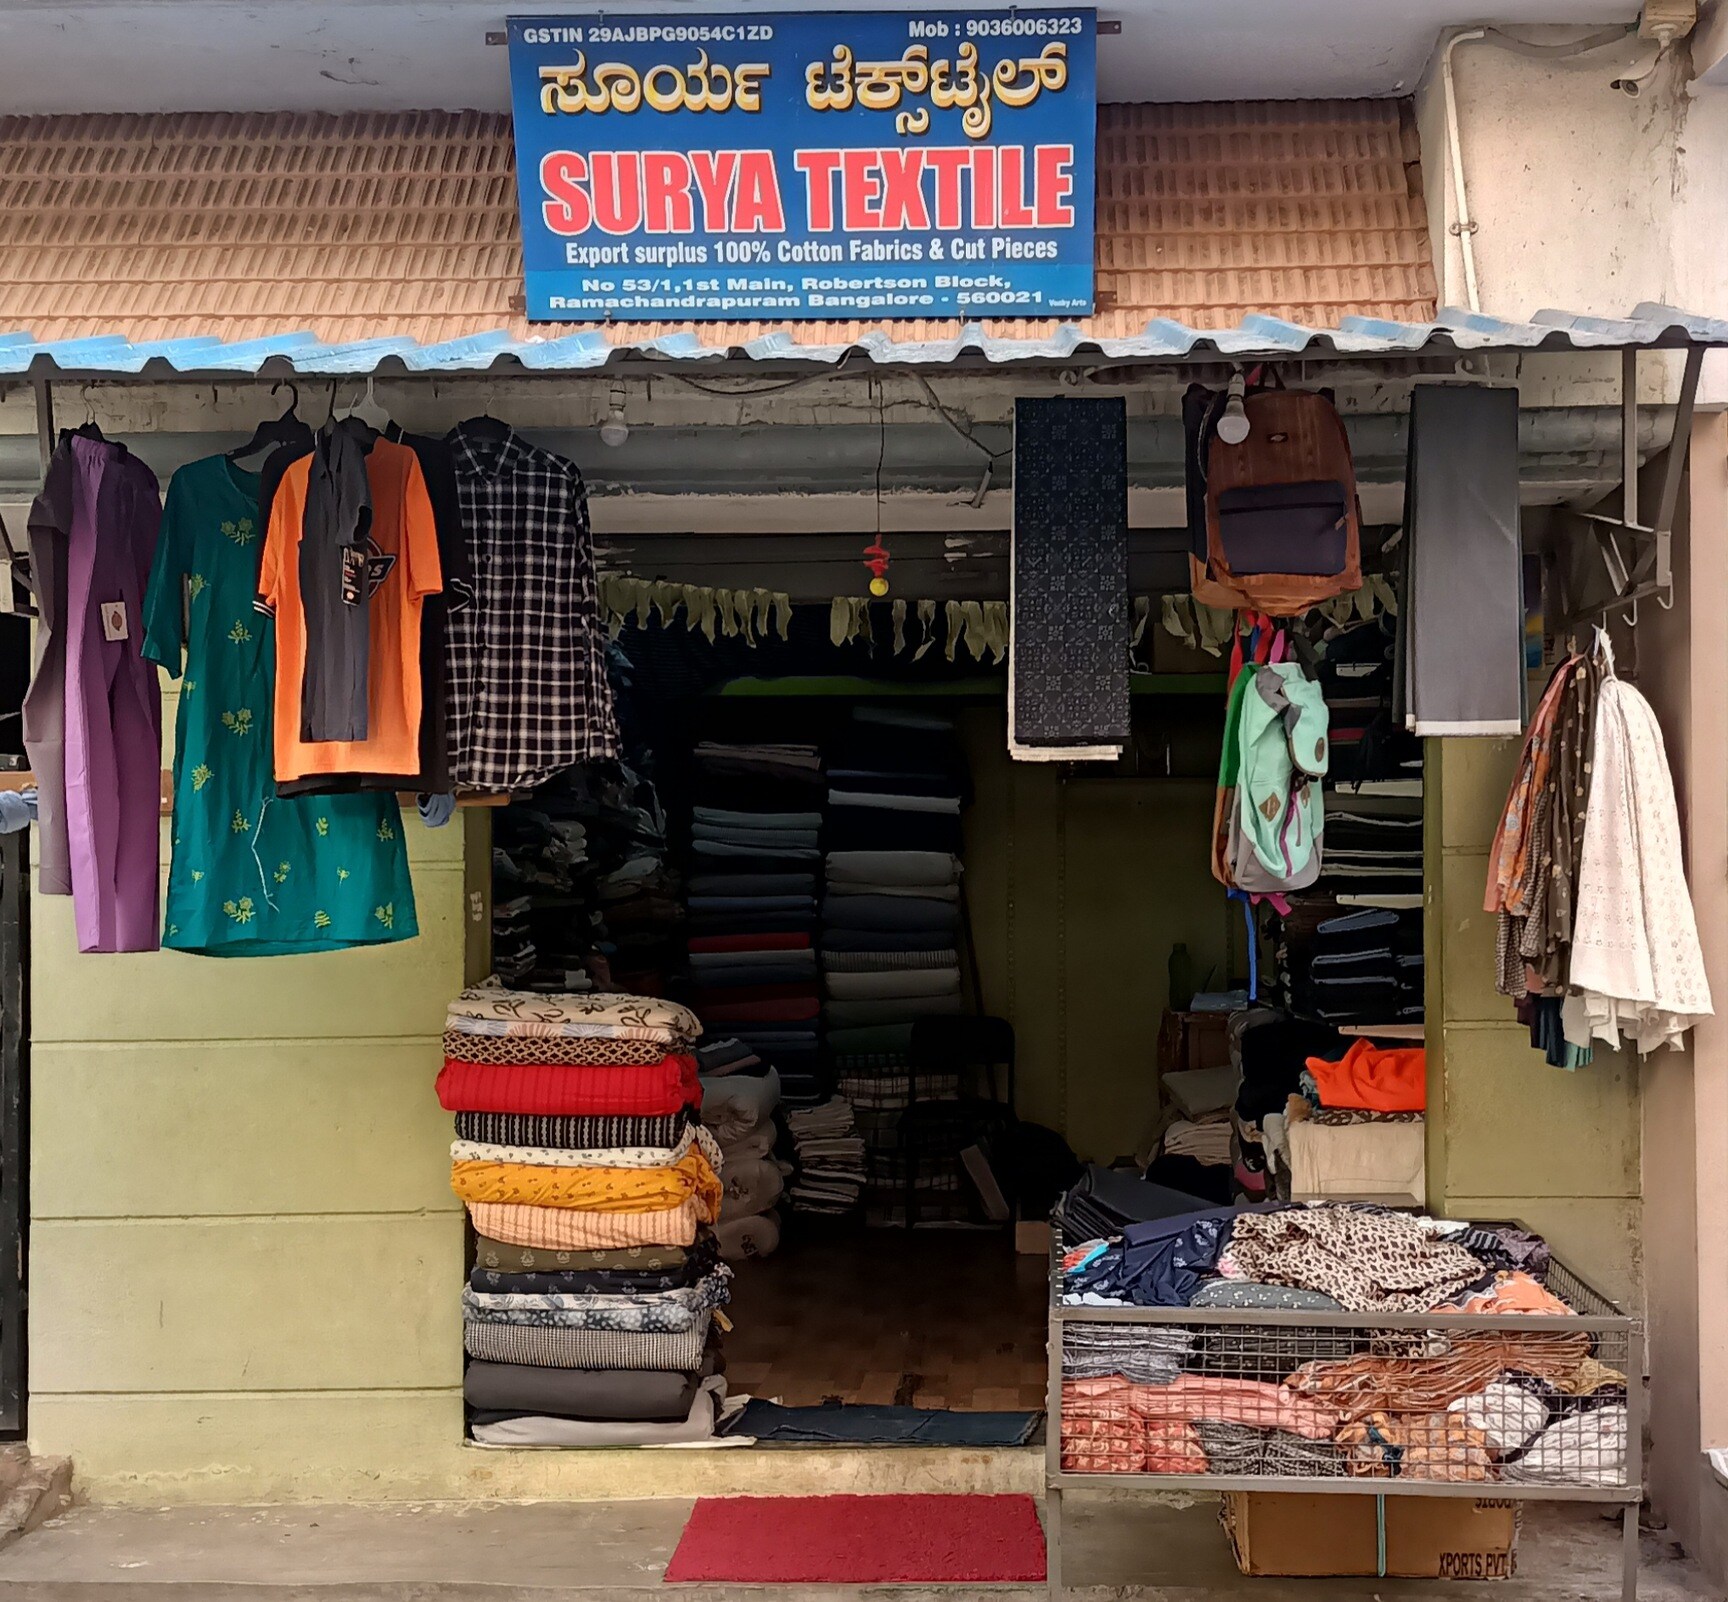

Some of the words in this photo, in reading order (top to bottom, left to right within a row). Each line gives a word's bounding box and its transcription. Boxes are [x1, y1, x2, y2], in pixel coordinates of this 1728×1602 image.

[523, 27, 583, 43] GSTIN
[588, 25, 773, 43] 29AJBPG9054C1ZD
[908, 20, 949, 38] Mob
[966, 17, 1083, 37] 9036006323
[538, 47, 771, 114] ಸೂರ್ಯ
[540, 150, 787, 236] SURYA
[794, 144, 1076, 231] TEXTILE
[565, 241, 630, 268] Export
[634, 241, 708, 268] surplus
[713, 240, 771, 263] 100%
[777, 239, 843, 263] Cotton
[849, 238, 923, 262] Fabrics
[928, 237, 944, 261] &
[950, 237, 986, 260] Cut
[991, 236, 1058, 259] Pieces
[582, 278, 615, 292] No
[726, 277, 794, 293] Main,
[801, 276, 928, 290] Robertson
[935, 275, 1012, 290] Block,
[549, 295, 800, 310] Ramachandrapuram
[808, 293, 934, 309] Bangalore
[956, 290, 1042, 305] 560021
[1438, 1552, 1483, 1577] XPORTS
